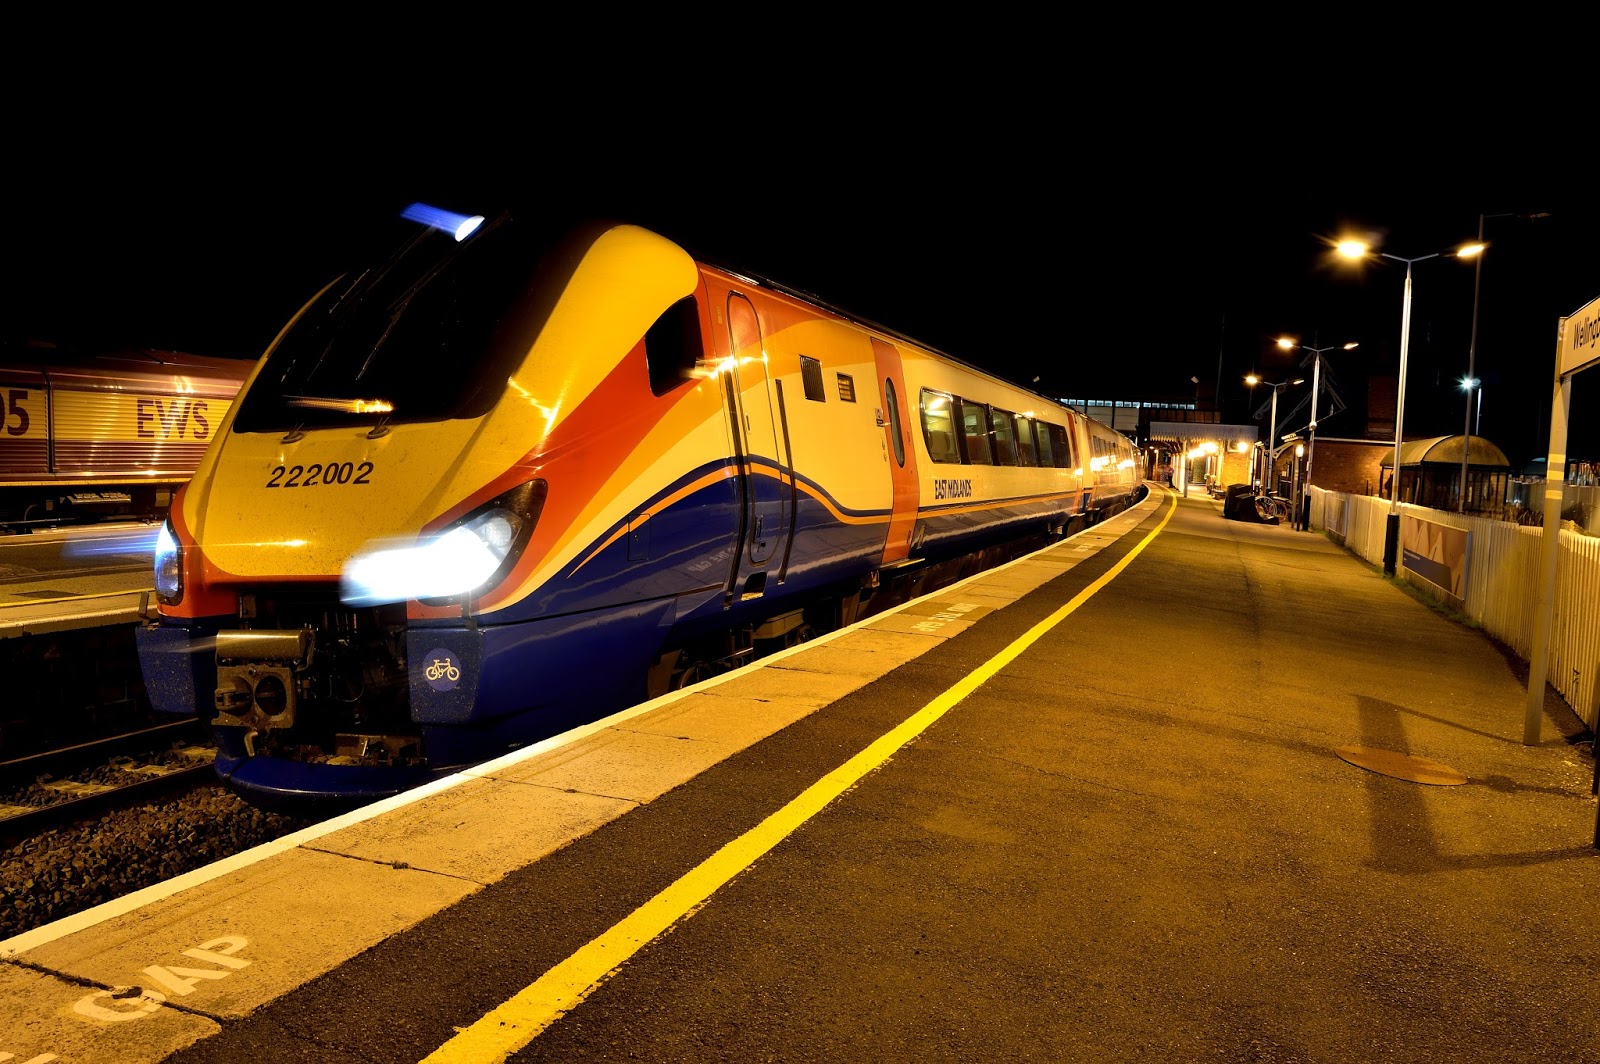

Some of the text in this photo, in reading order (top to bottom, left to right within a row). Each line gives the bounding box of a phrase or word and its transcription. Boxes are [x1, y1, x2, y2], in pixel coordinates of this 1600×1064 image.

[0, 390, 30, 437] 5
[137, 399, 209, 439] EWS
[265, 461, 374, 488] 222002
[934, 479, 972, 500] EAST MIDLANDS
[73, 935, 252, 1022] GAP
